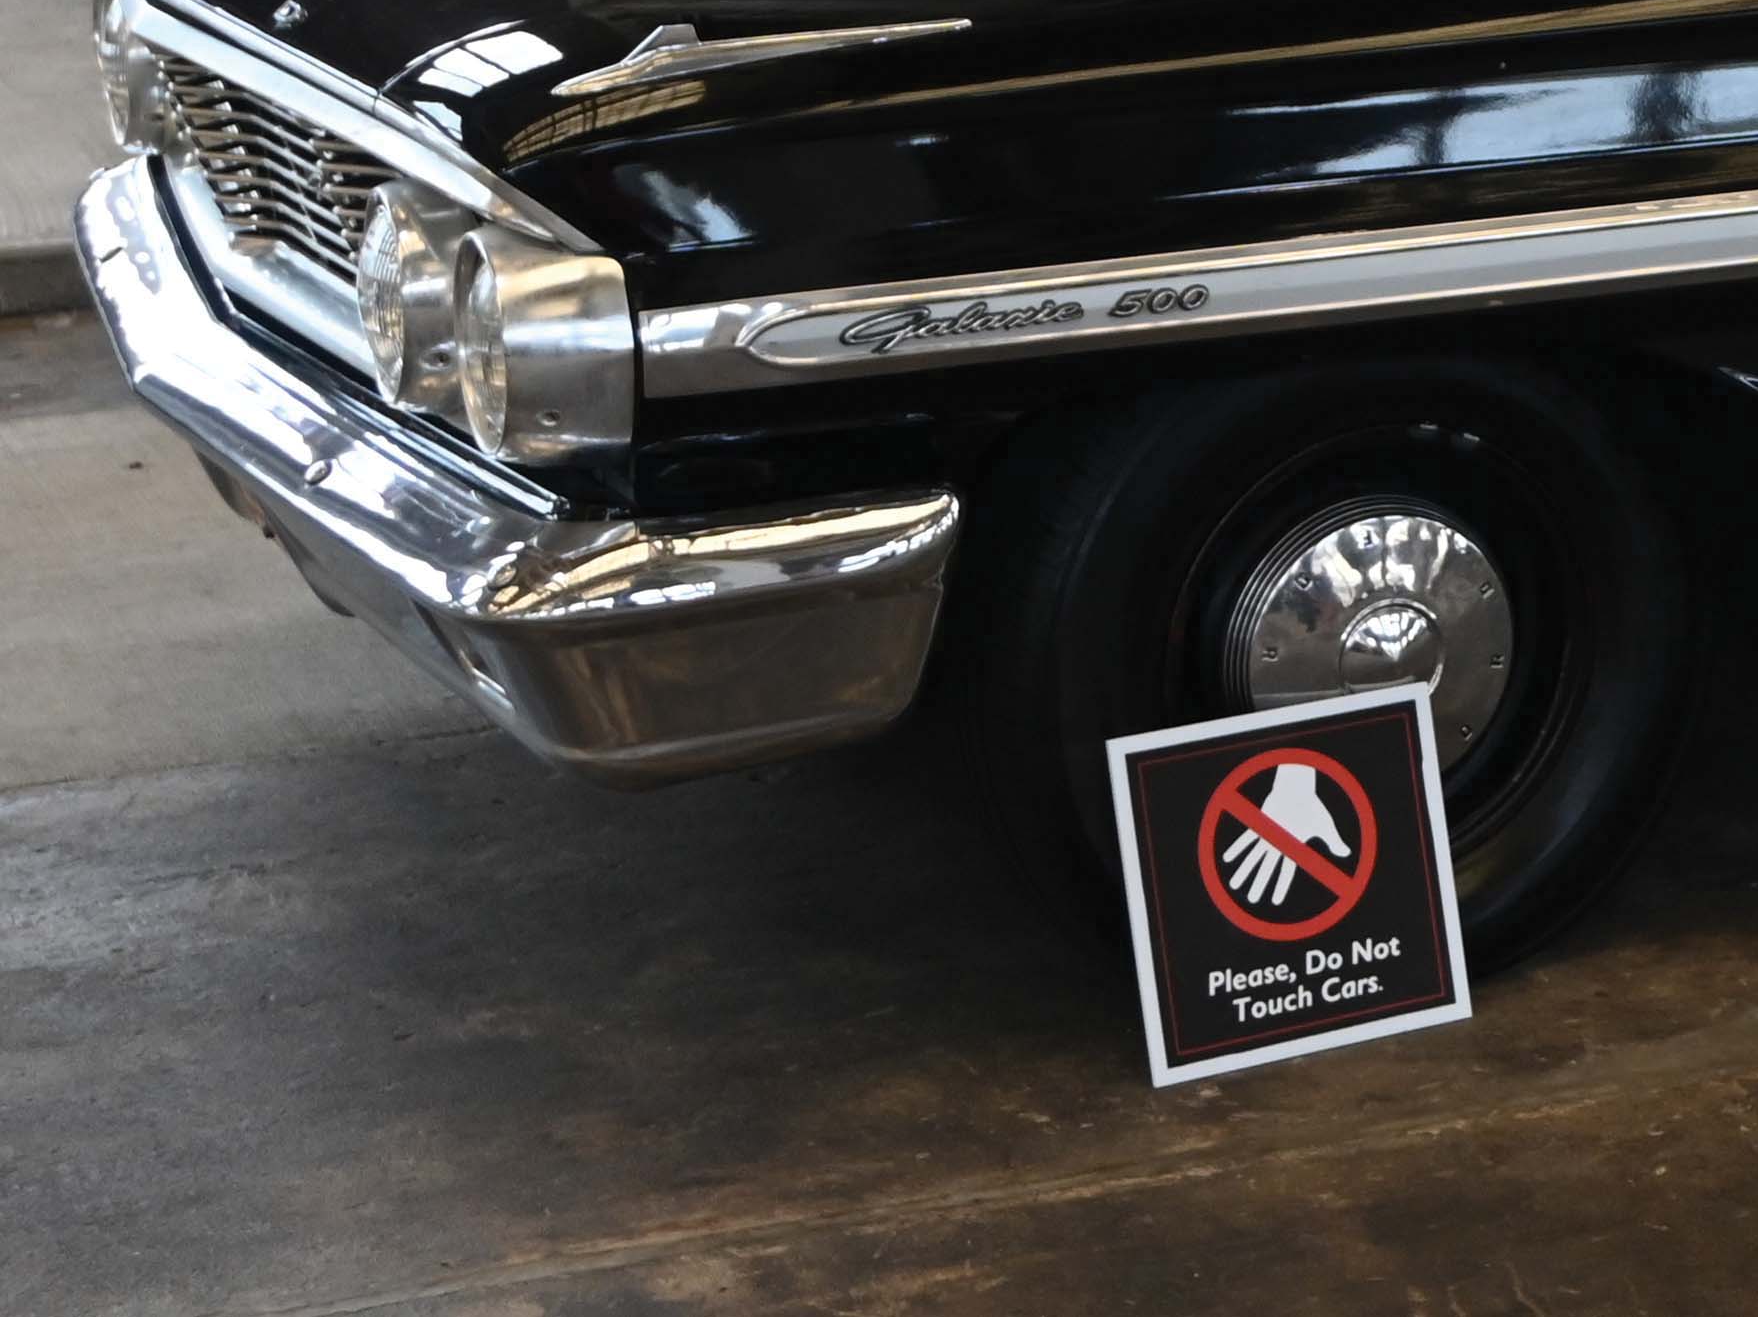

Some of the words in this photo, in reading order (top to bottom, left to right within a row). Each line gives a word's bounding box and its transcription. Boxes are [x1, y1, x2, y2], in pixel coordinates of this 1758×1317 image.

[839, 298, 1085, 354] Galaxie
[1108, 283, 1210, 319] 500
[1207, 964, 1297, 997] Please,
[1305, 950, 1344, 975] Do
[1351, 935, 1401, 965] Not
[1231, 985, 1313, 1022] Touch
[1321, 973, 1384, 1002] Cars.
